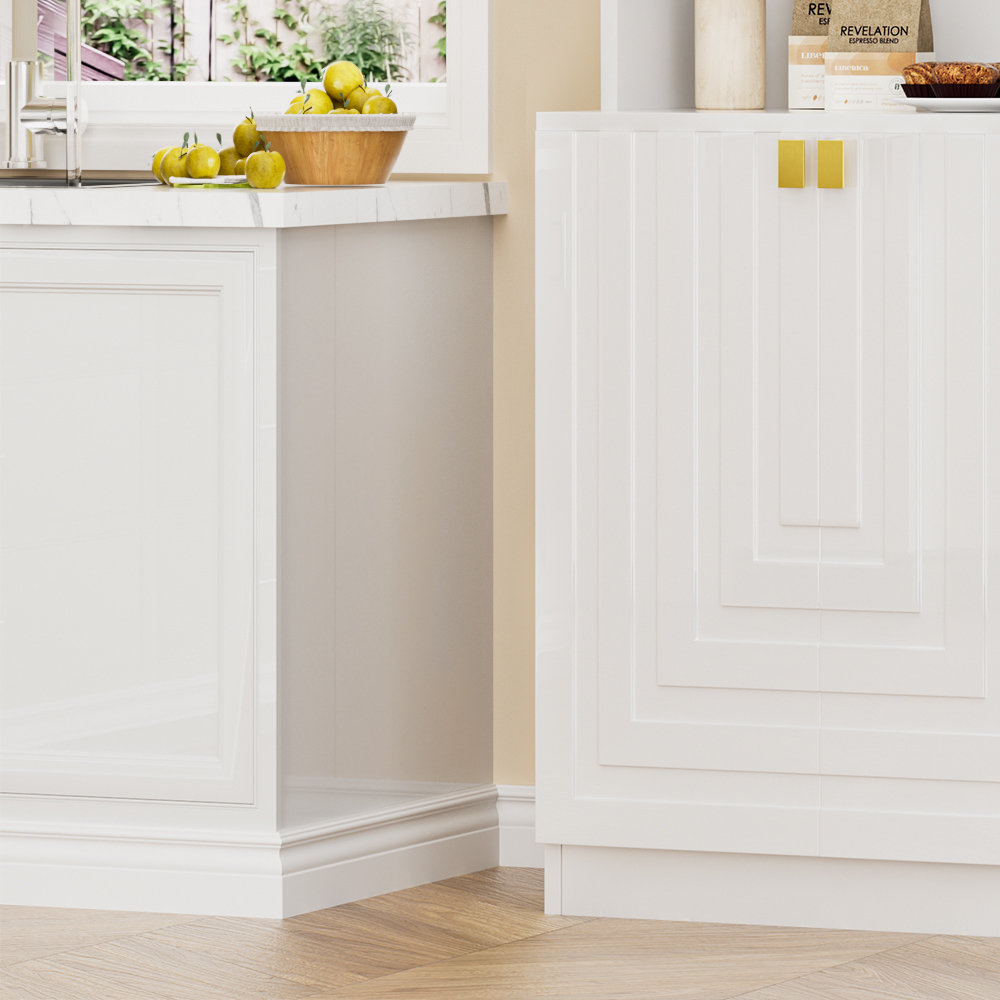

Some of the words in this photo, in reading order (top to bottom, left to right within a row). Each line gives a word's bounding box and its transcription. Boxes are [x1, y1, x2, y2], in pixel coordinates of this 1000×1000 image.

[840, 25, 909, 36] REVELATION
[849, 37, 878, 45] ESPRESSO
[879, 37, 899, 45] BLEND
